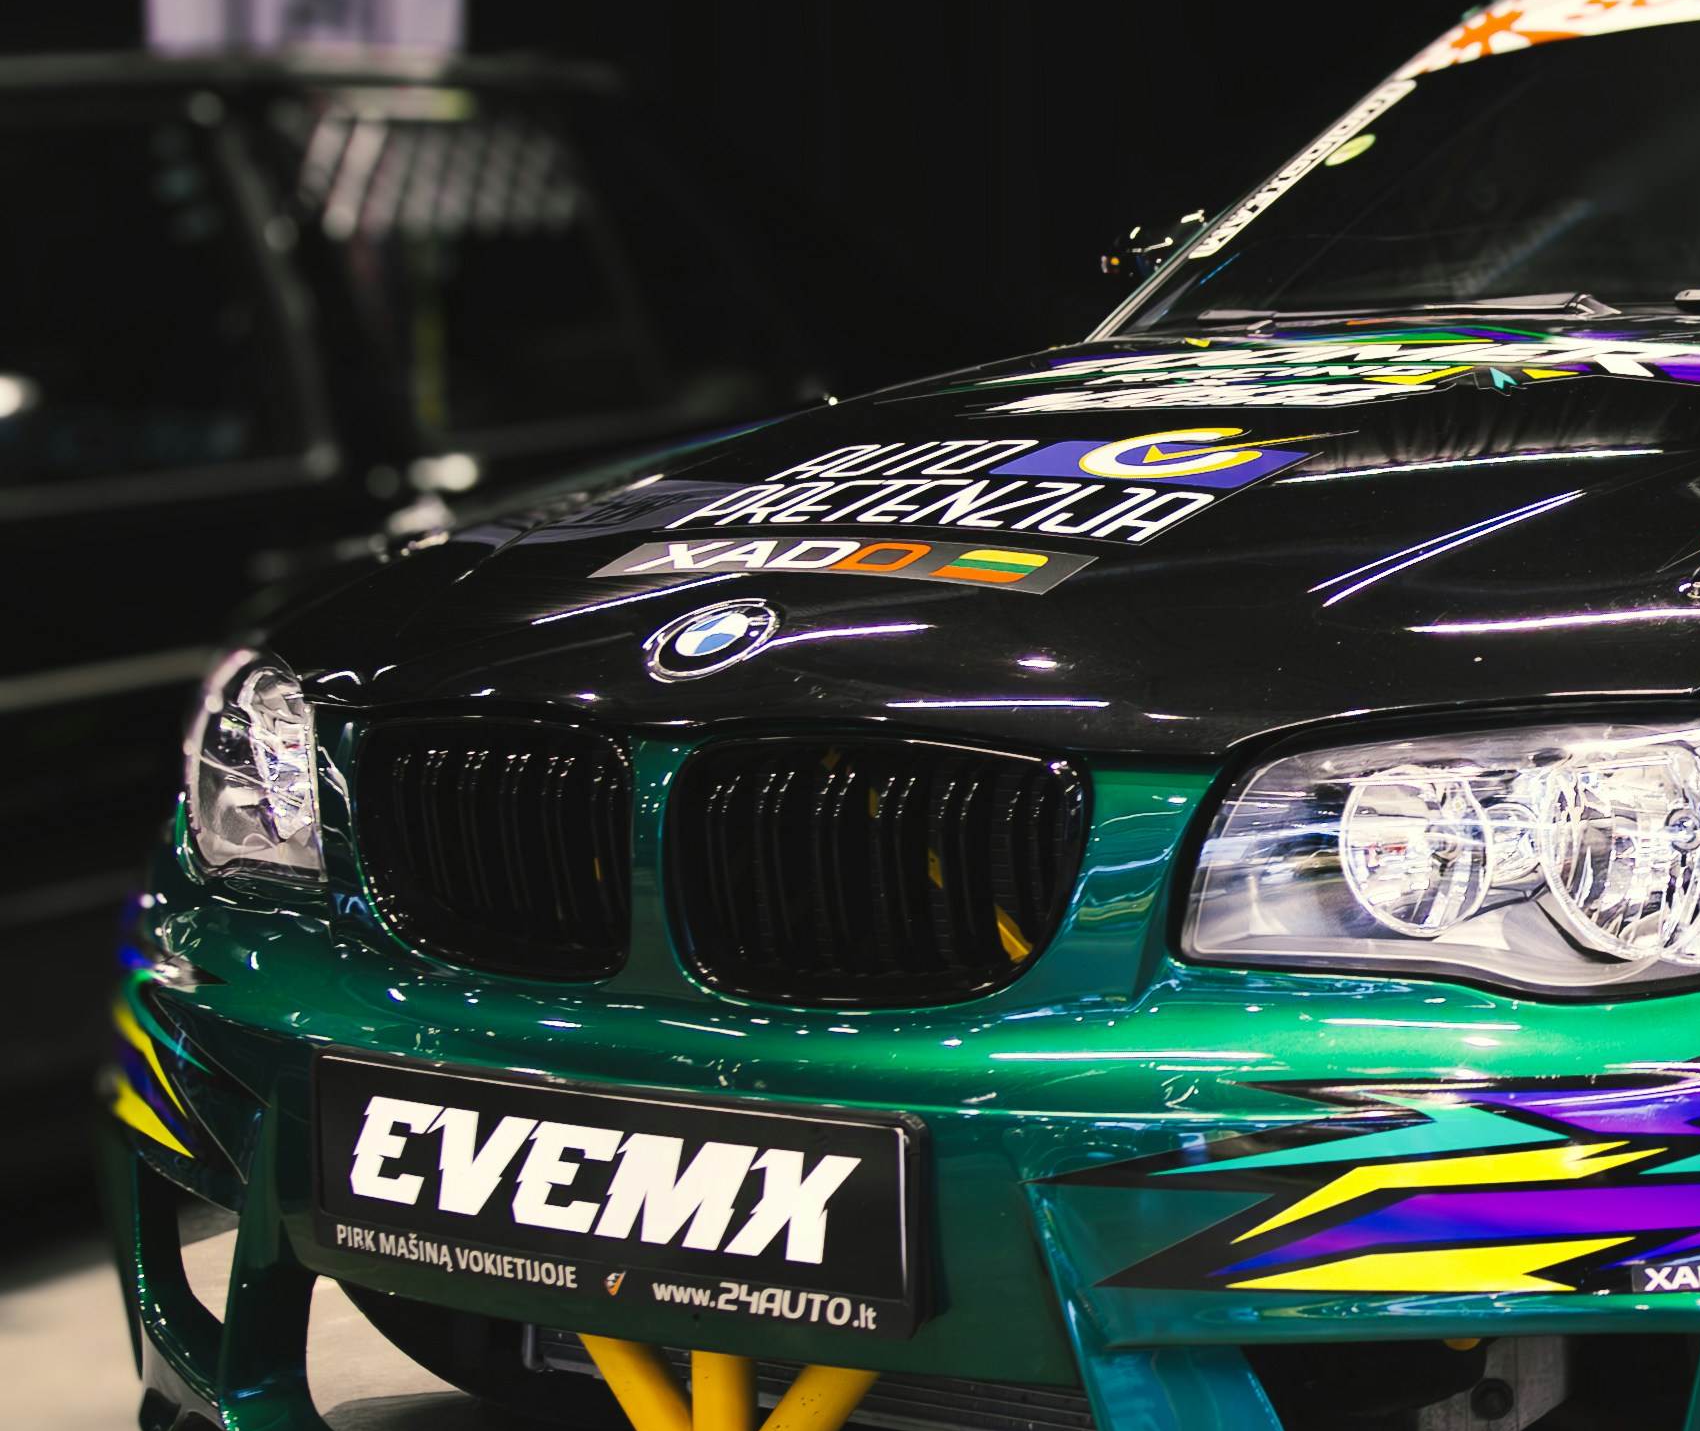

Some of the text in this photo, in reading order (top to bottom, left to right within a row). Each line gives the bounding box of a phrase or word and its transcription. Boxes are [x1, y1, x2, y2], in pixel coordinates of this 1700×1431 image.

[766, 439, 1040, 482] AUTO
[665, 480, 1216, 542] PRETENZIJA
[624, 541, 932, 572] XADO
[349, 1095, 862, 1265] EVEMX
[336, 1223, 877, 1331] PIRK MAŠINĄ VOKIETIJOJE www.24AUTO.lt
